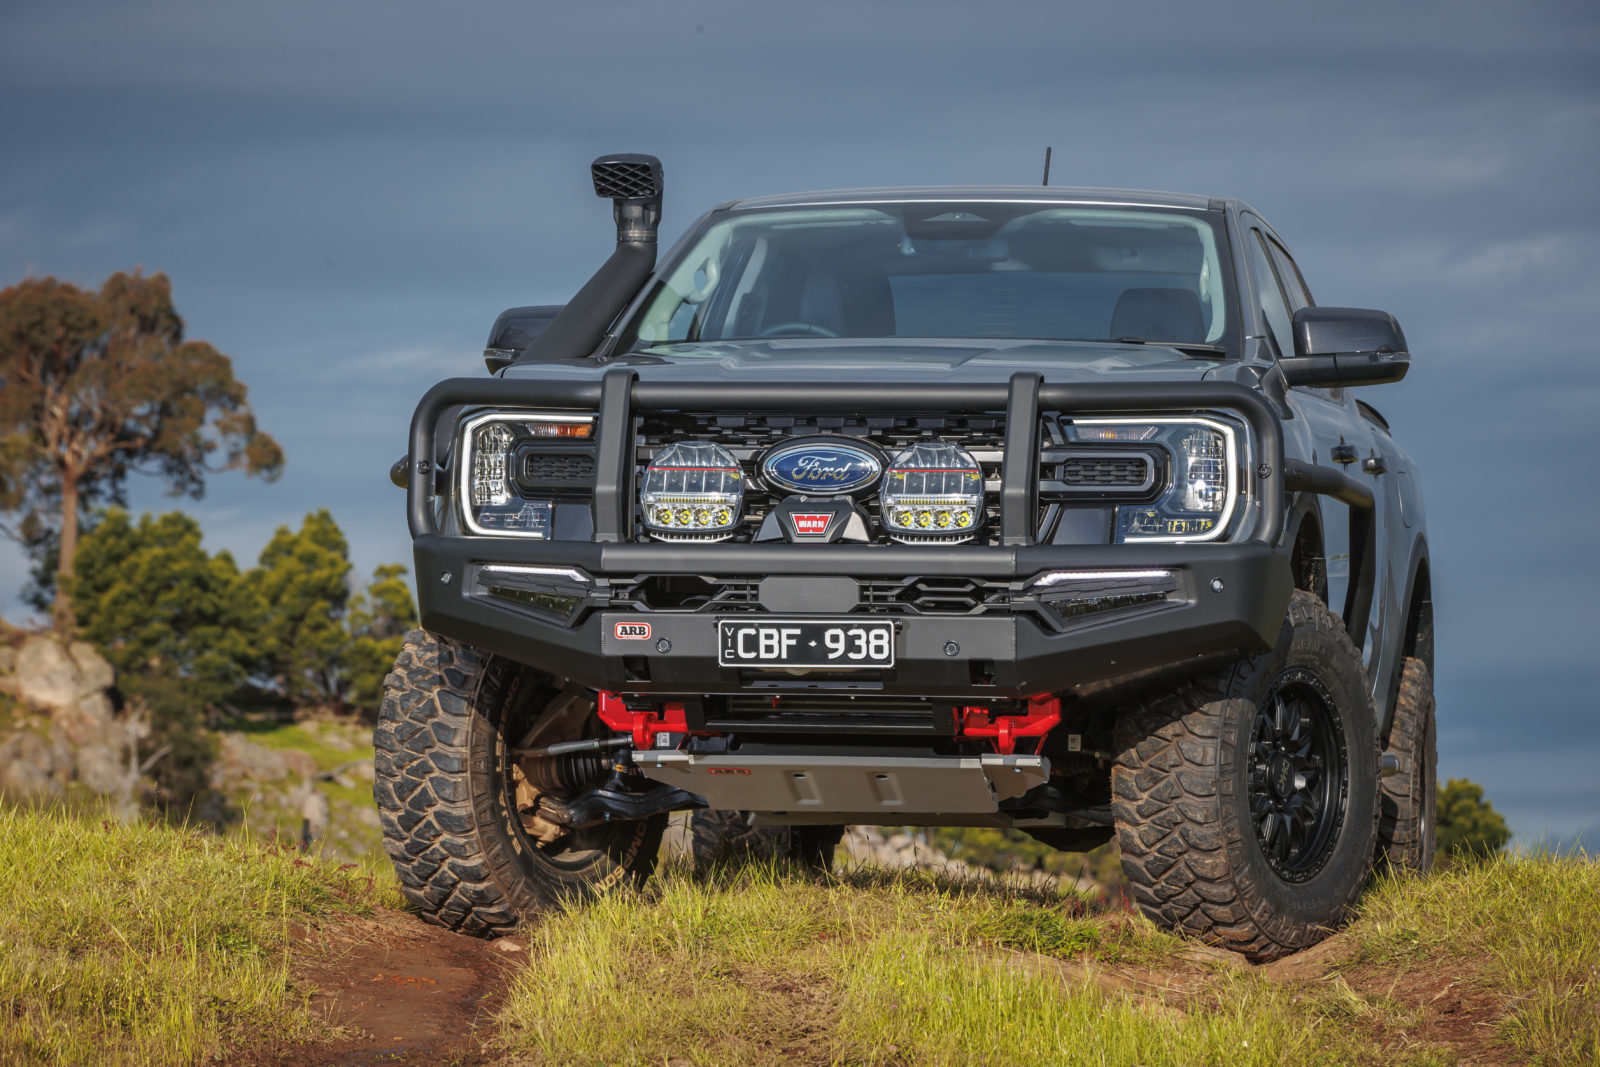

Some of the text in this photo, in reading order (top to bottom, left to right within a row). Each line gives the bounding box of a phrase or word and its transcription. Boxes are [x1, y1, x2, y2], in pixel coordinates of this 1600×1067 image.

[791, 455, 852, 480] Ford
[798, 520, 825, 528] WARN
[619, 625, 647, 636] ARB
[737, 628, 889, 660] CBF 938
